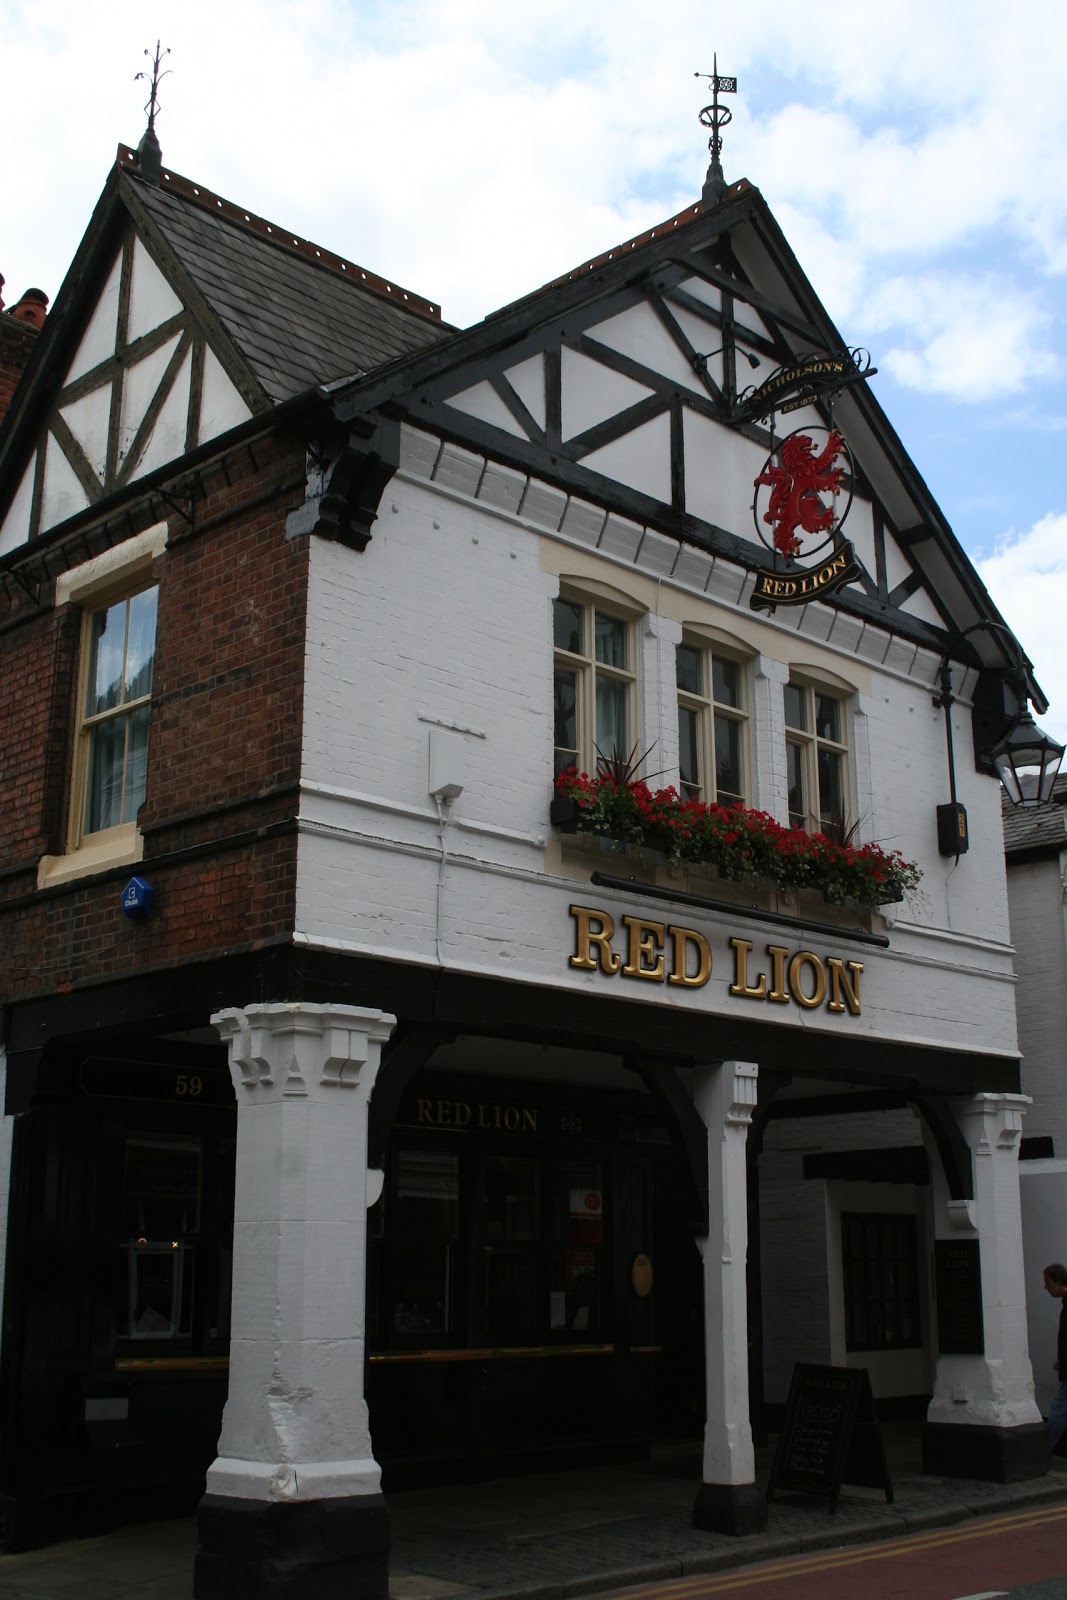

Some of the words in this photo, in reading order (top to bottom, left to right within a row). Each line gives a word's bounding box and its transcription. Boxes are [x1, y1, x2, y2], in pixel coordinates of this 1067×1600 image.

[752, 362, 845, 402] NICHOLSON'S
[800, 395, 818, 406] 1873
[761, 577, 797, 597] RED
[800, 552, 847, 594] LION
[569, 904, 713, 988] RED
[729, 936, 864, 1015] LION
[176, 1074, 203, 1096] 59
[416, 1098, 472, 1127] RED
[477, 1103, 539, 1133] LION
